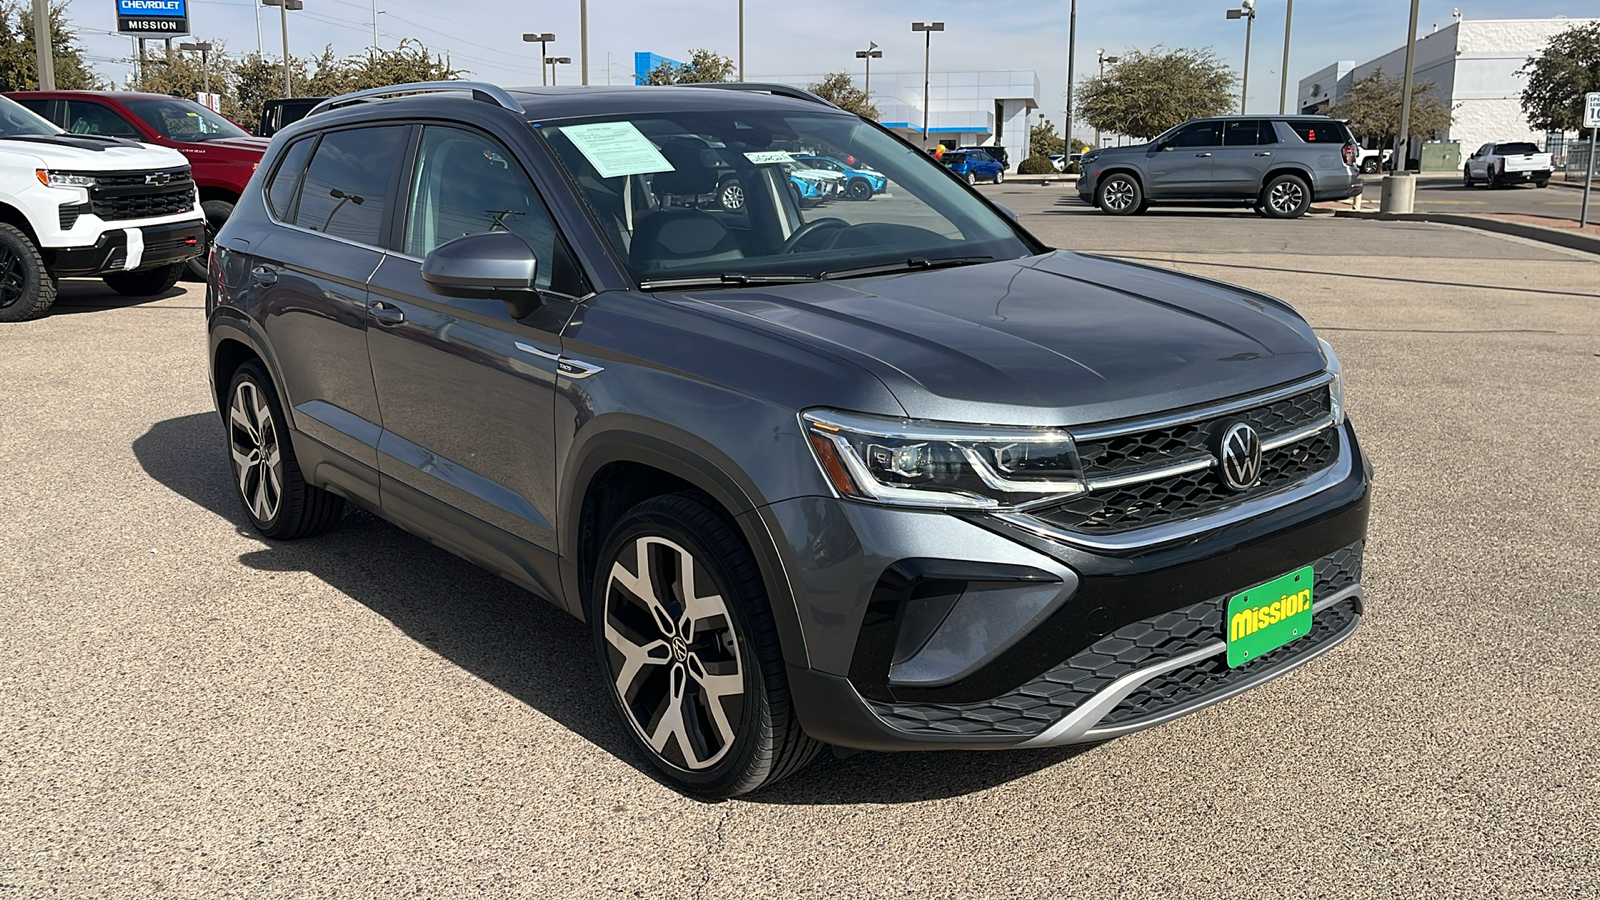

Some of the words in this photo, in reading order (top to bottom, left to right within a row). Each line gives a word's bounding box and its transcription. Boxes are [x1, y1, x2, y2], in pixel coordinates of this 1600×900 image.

[121, 0, 180, 10] CHEVROLET
[128, 20, 177, 30] MISSION
[1231, 588, 1310, 642] Mission
